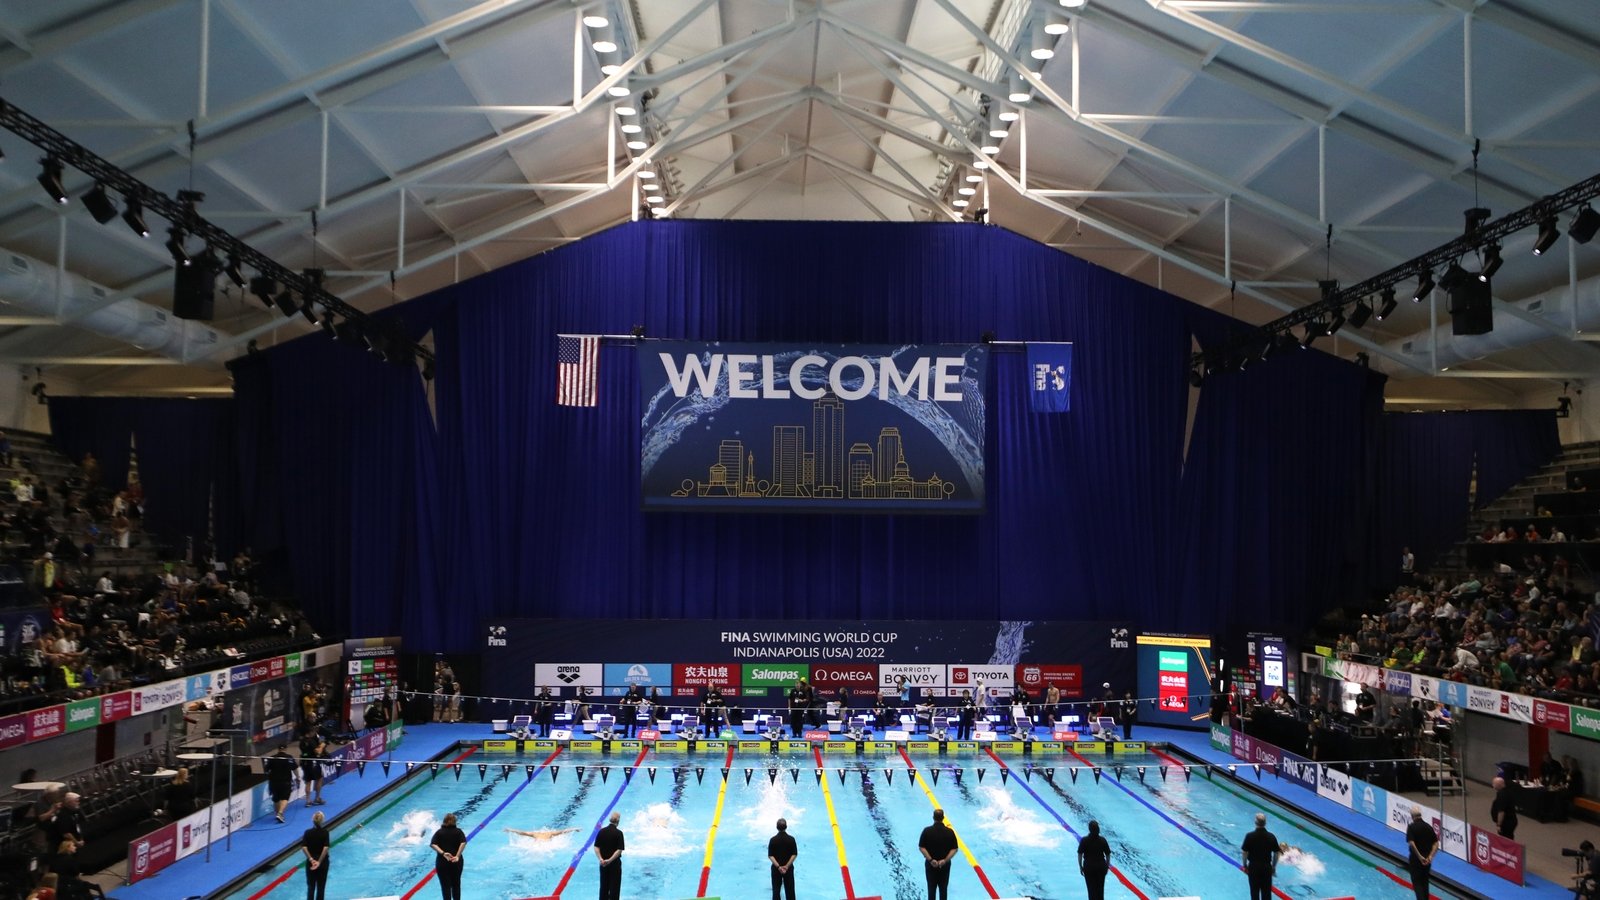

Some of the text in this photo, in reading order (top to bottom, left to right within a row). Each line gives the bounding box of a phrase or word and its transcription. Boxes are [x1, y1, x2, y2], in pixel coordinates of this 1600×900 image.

[658, 352, 966, 401] WELCOME
[488, 636, 507, 647] Fina
[721, 632, 898, 643] FINA SWIMMING WORLD CUP
[1110, 638, 1129, 649] Fina
[733, 647, 885, 660] INDIANAPOLIS (USA) 2022
[557, 665, 581, 673] arena
[685, 666, 728, 678] 农夫山泉
[751, 668, 799, 682] Salonpas
[830, 671, 874, 681] OMEGA
[884, 674, 938, 684] BONVOY
[972, 672, 1009, 680] TOYOTA
[1576, 713, 1600, 733] Salonpa
